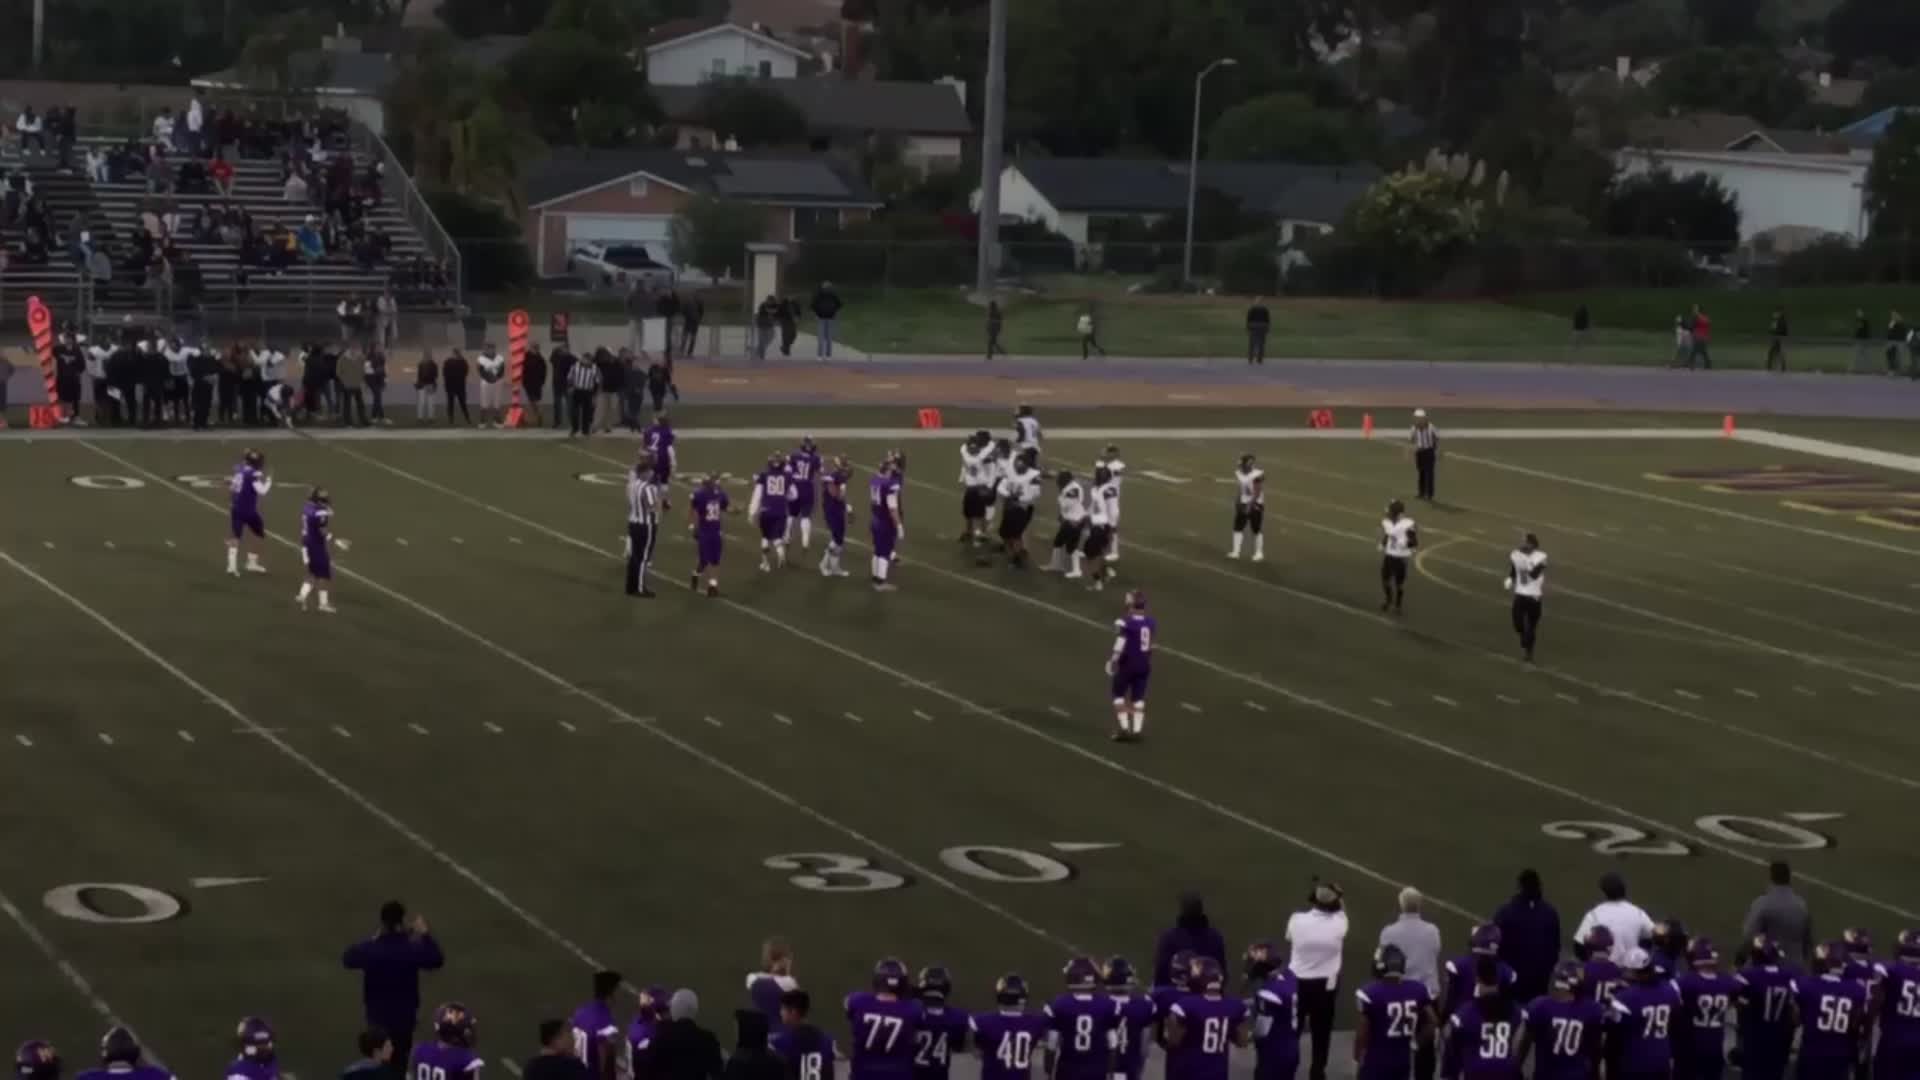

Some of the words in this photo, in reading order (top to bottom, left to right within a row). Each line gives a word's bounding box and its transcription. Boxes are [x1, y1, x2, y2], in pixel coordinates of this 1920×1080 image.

[767, 475, 785, 496] 60
[1141, 626, 1150, 652] 9
[1387, 1001, 1417, 1037] 25
[1641, 1004, 1671, 1039] 79
[1763, 987, 1788, 1021] 17
[1817, 995, 1852, 1034] 56
[863, 1013, 903, 1053] 77
[914, 1031, 948, 1066] 24
[997, 1032, 1030, 1069] 40
[1075, 1015, 1092, 1051] 8
[1203, 1018, 1229, 1054] 61
[1480, 1022, 1511, 1059] 58
[1551, 1017, 1583, 1056] 70
